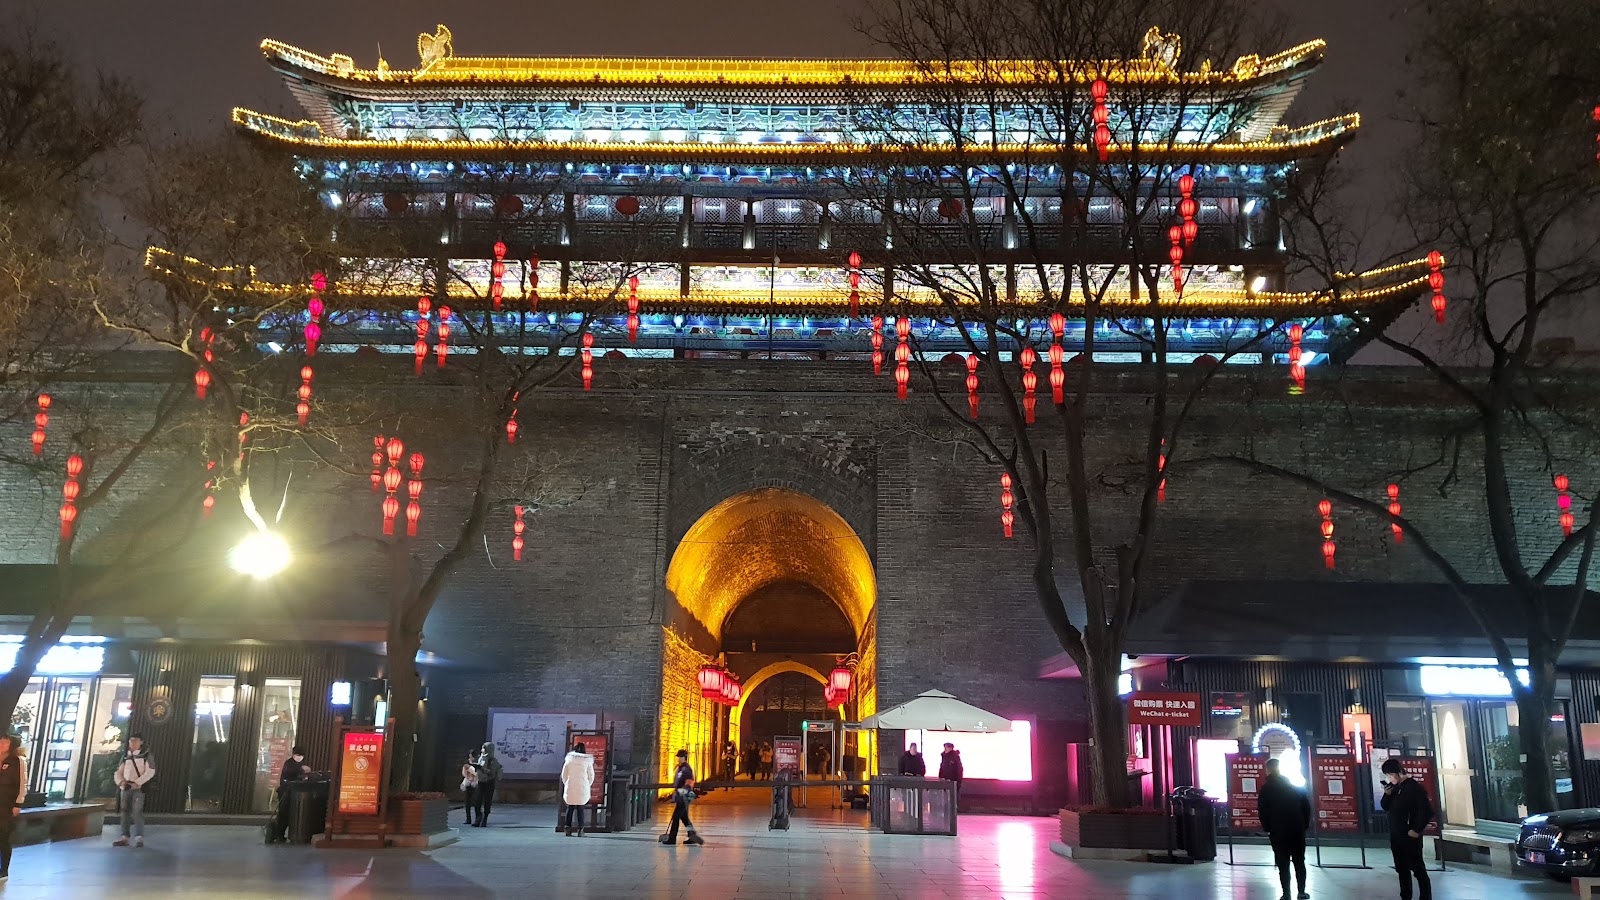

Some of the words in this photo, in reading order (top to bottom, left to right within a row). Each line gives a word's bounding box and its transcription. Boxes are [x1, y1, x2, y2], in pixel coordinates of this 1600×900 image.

[1133, 699, 1163, 708] 微信购票
[1165, 701, 1195, 709] 快速入园
